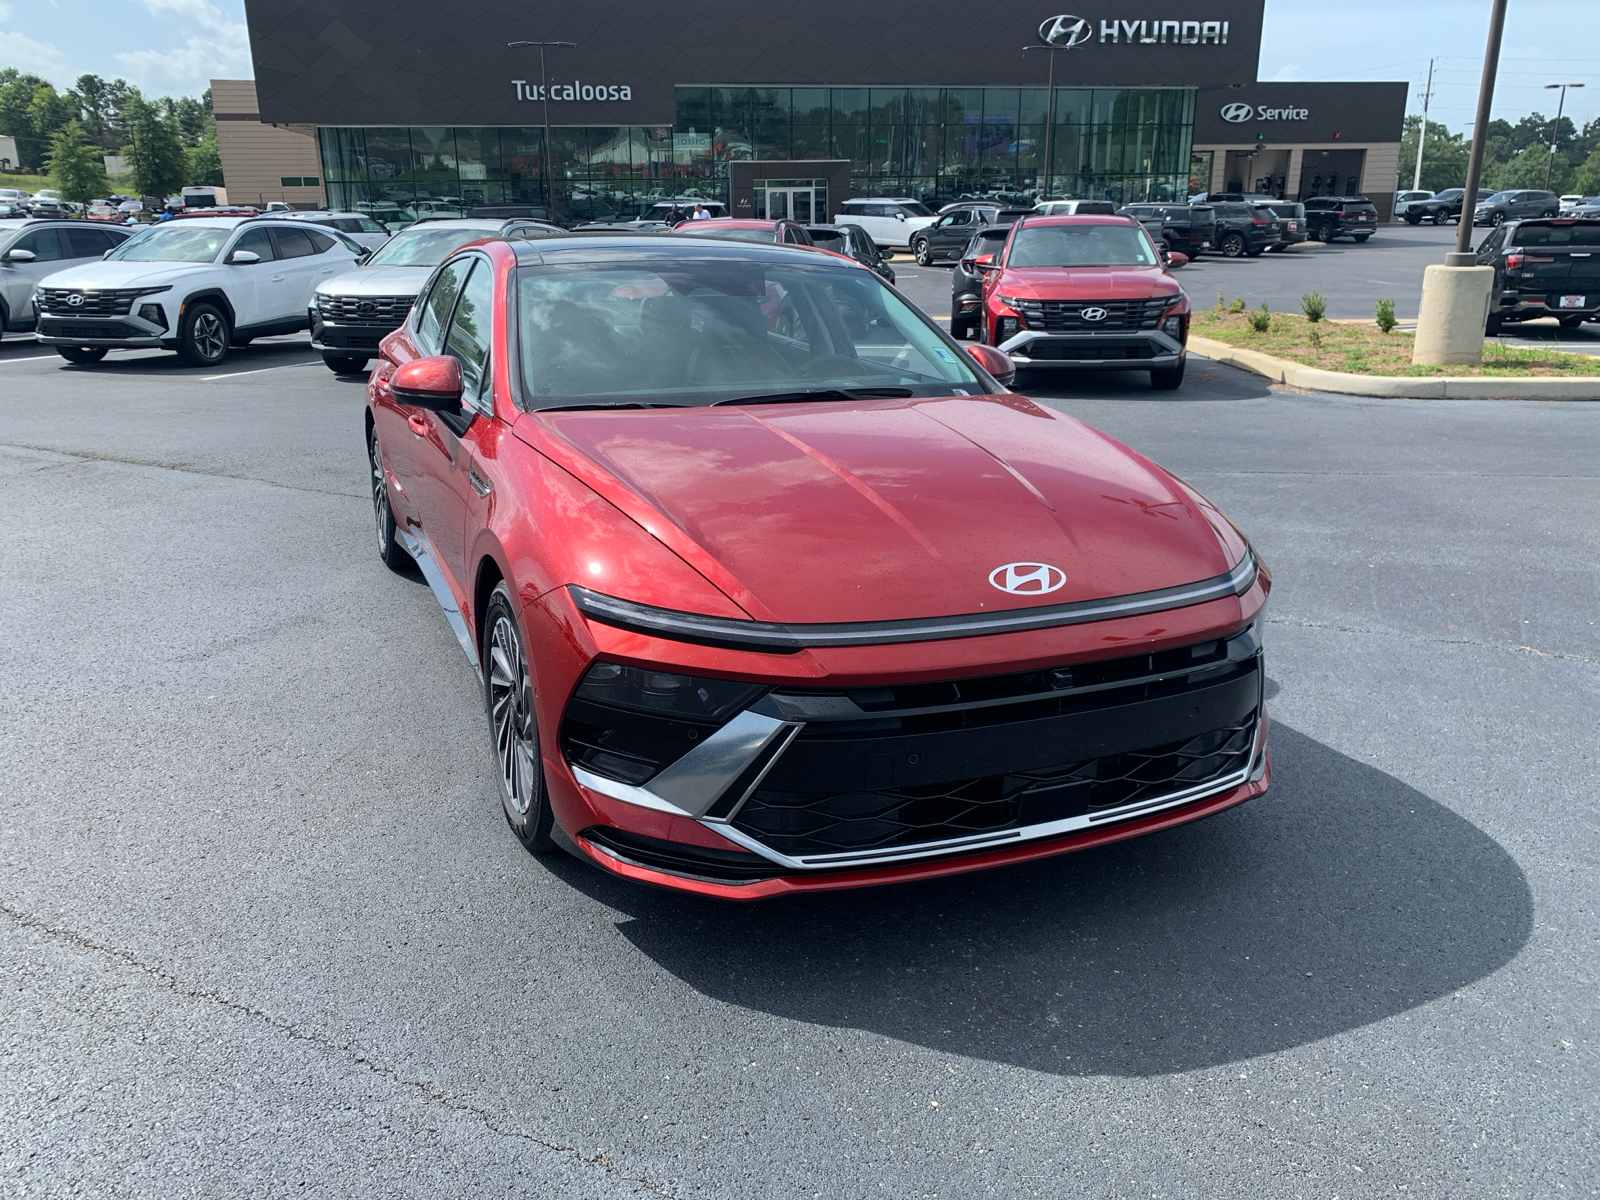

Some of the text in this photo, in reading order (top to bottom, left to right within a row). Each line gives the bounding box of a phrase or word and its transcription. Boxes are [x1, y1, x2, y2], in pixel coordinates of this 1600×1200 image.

[1099, 19, 1229, 44] HYUNDAI
[511, 80, 632, 101] Tuscaloosa
[1256, 105, 1309, 121] Service
